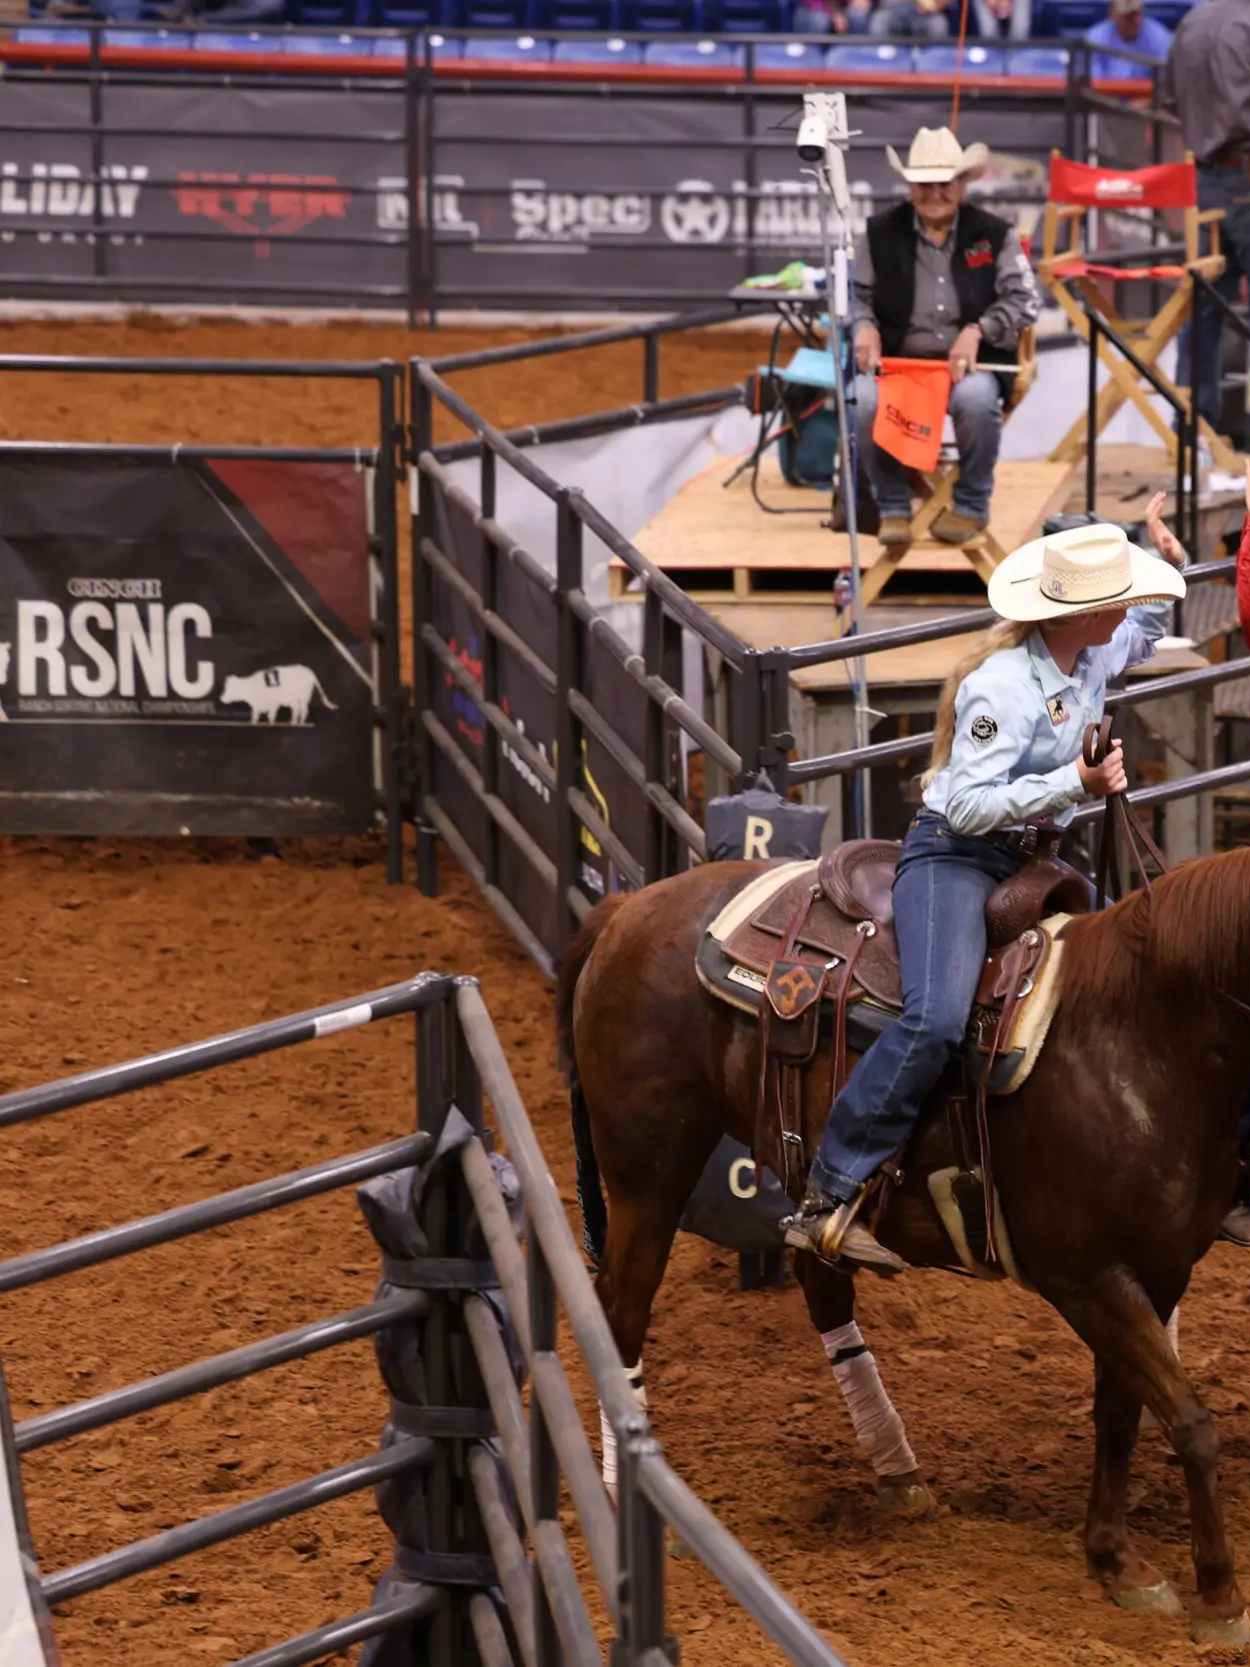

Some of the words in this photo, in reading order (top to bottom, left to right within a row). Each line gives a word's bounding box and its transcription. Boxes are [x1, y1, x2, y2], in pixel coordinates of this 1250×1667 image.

[17, 600, 215, 699] RSNC
[743, 814, 774, 861] R
[728, 1157, 758, 1199] C
